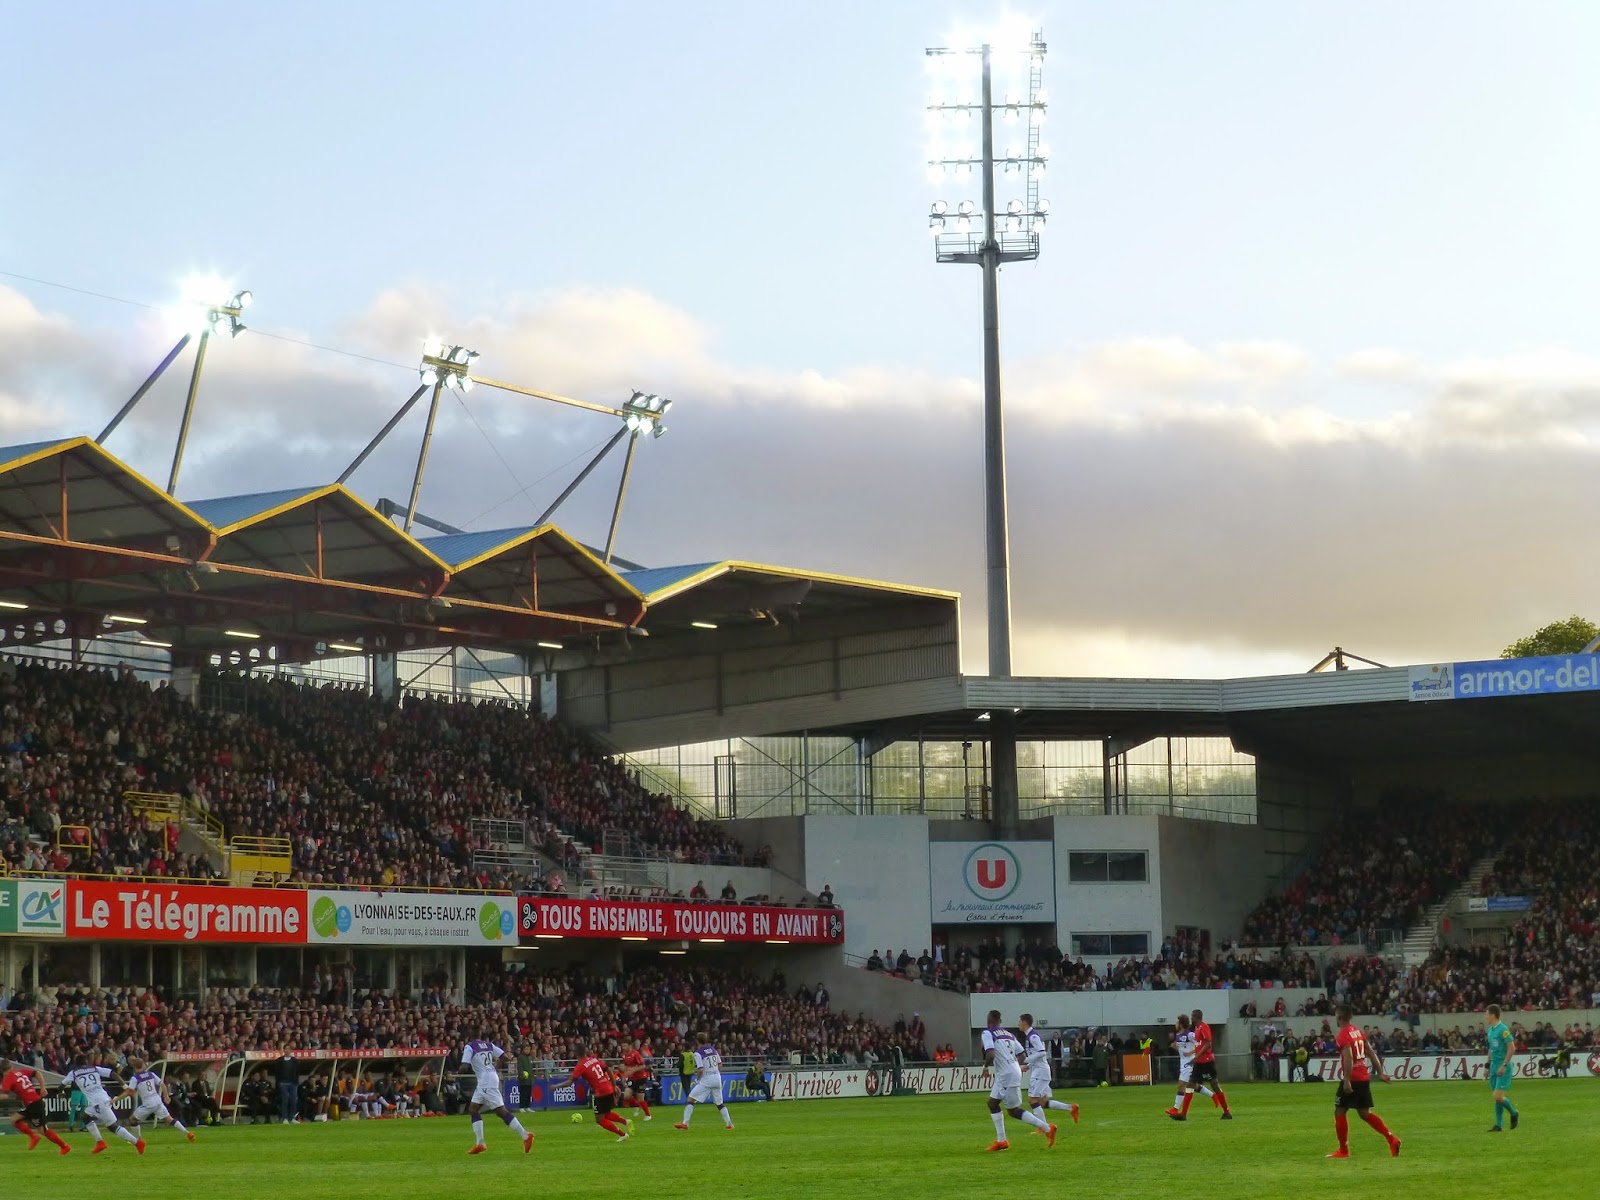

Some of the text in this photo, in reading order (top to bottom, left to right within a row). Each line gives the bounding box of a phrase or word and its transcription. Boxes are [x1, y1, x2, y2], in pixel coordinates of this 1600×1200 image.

[1460, 657, 1600, 694] armor-del
[976, 859, 1007, 890] U
[75, 889, 300, 940] Le Télégramme
[354, 904, 477, 921] LYONNAISE-DES-EAUX.FR
[541, 905, 581, 930] TOUS
[589, 907, 667, 936] ENSEMBLE,
[674, 910, 747, 935] TOUJOURS
[753, 913, 770, 935] EN
[776, 914, 818, 936] AVANT
[362, 926, 376, 935] Pour
[377, 926, 393, 936] l'eau,
[394, 929, 407, 938] pour
[429, 927, 449, 938] chaque
[450, 927, 469, 937] instant
[1354, 1039, 1365, 1059] 12
[1124, 1074, 1148, 1082] orange
[1393, 1057, 1422, 1080] de
[79, 1073, 97, 1088] 29
[145, 1080, 153, 1092] 8
[929, 1068, 945, 1091] de
[554, 1091, 576, 1102] france
